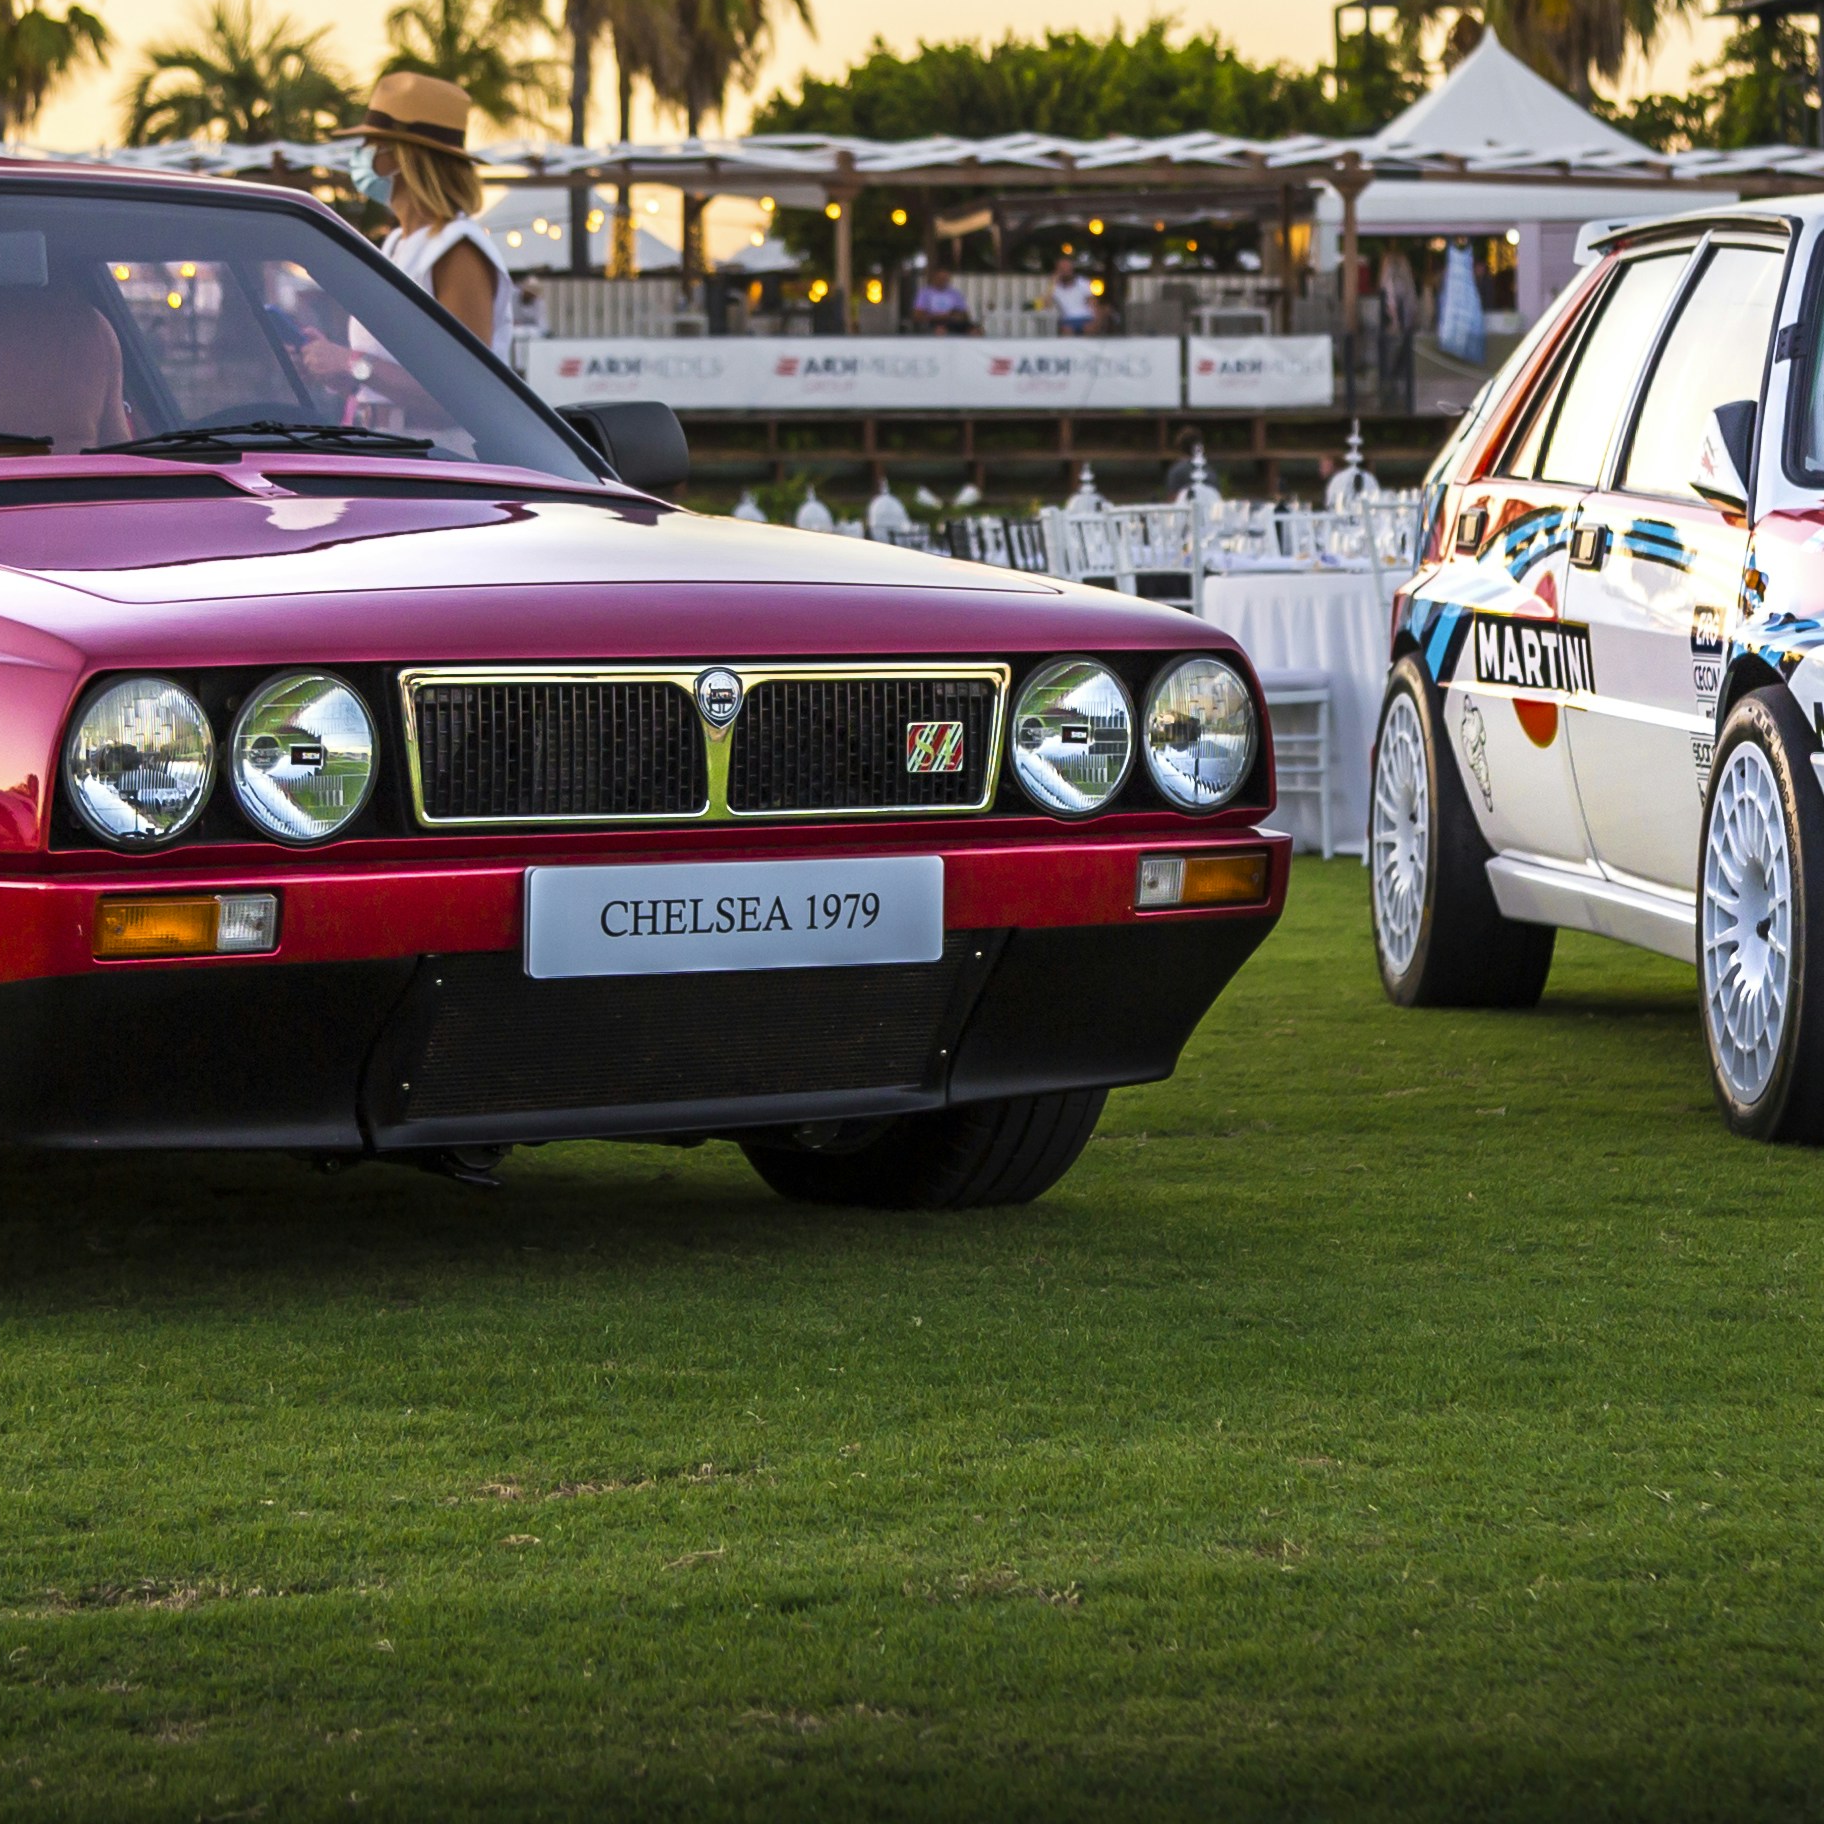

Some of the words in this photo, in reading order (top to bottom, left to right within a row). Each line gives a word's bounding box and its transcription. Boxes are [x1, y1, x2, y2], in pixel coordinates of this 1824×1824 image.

[1696, 611, 1720, 646] ERG
[1478, 622, 1591, 694] MARTINI
[599, 895, 793, 938] CHELSEA
[806, 892, 881, 931] 1979
